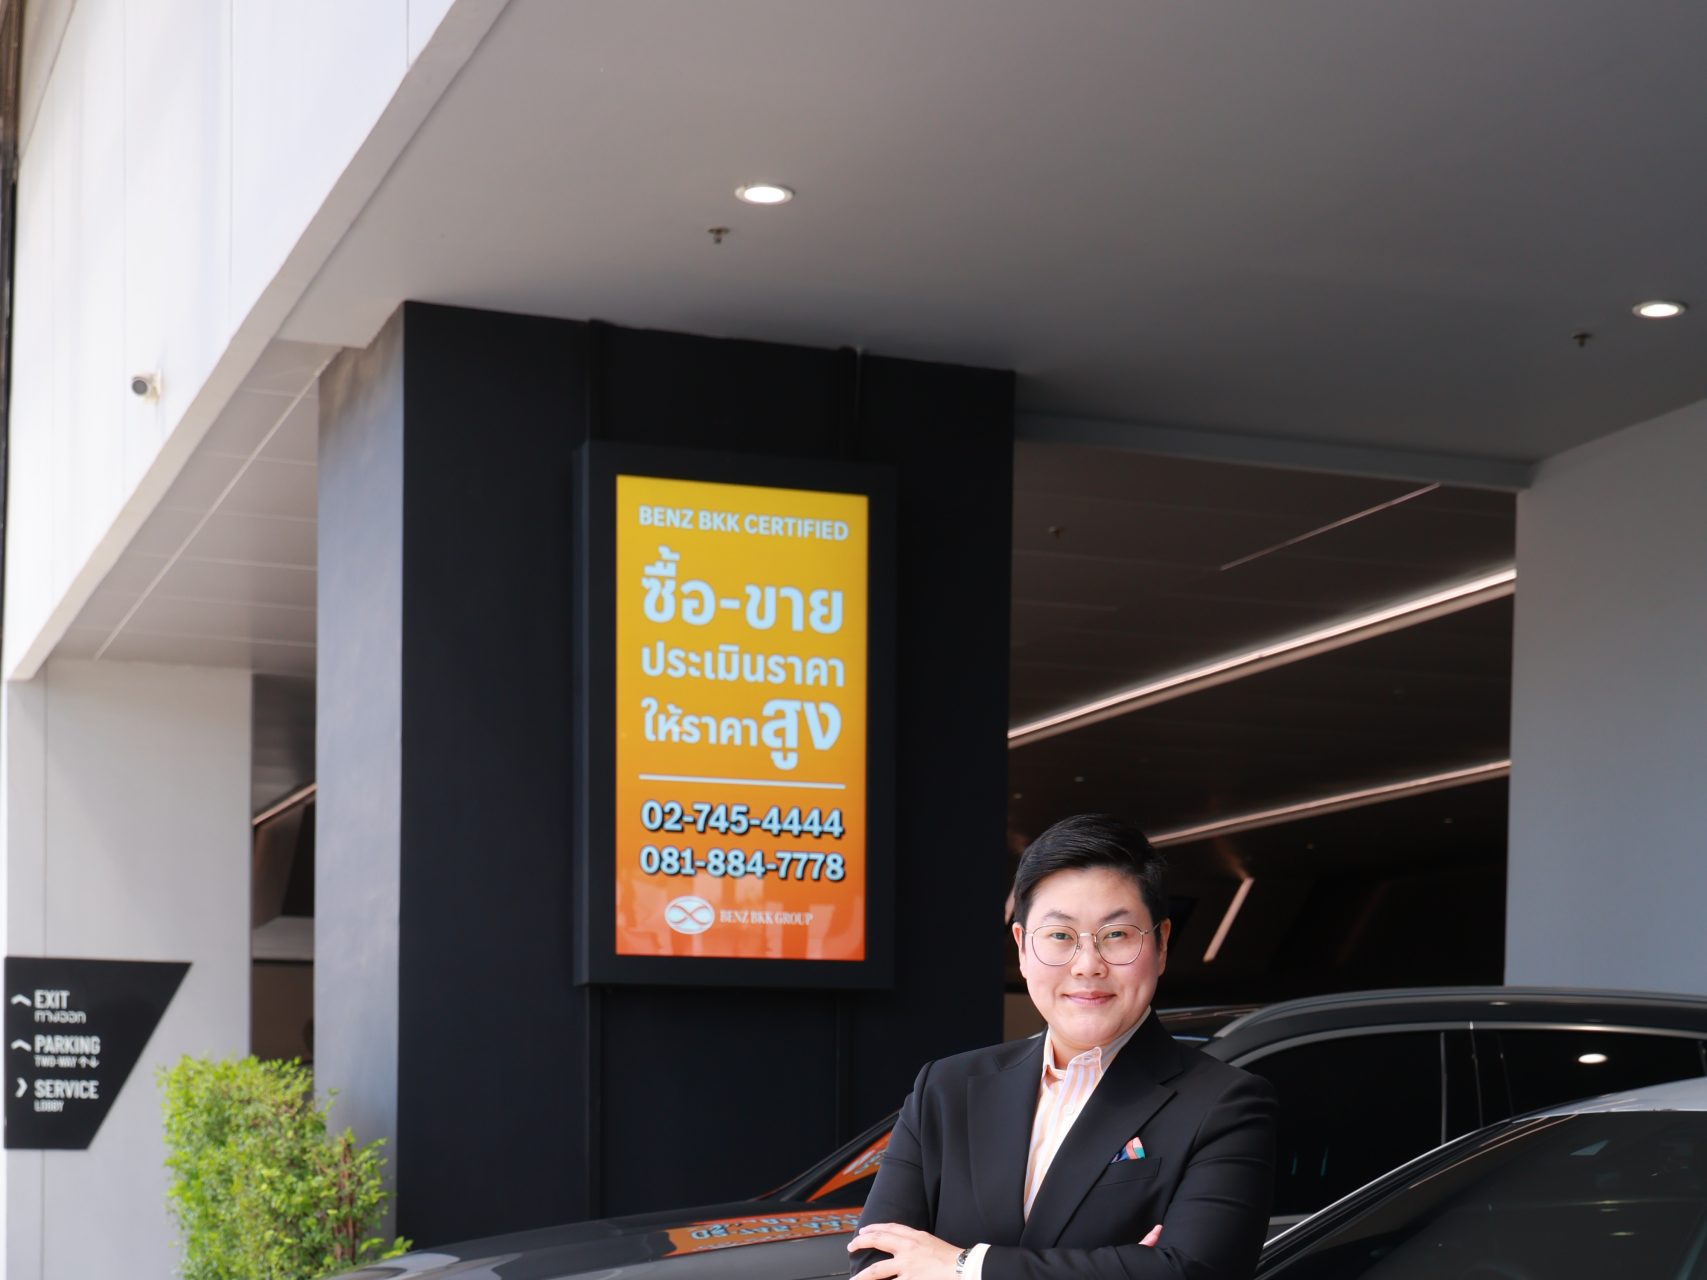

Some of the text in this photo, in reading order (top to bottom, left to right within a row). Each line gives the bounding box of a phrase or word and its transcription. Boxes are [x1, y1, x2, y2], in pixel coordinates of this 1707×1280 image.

[639, 504, 849, 541] BENZ BKK CERTIFIED
[641, 545, 843, 634] ซื้อ-ขาย
[641, 641, 845, 687] ประเมินราคา
[640, 800, 845, 838] 02-745-4444
[639, 845, 846, 882] 081-884-7778
[720, 909, 813, 927] BENZ BKK GROUP
[34, 989, 70, 1010] EXIT
[34, 1010, 87, 1024] ทางออก
[34, 1034, 100, 1055] PARKING
[34, 1055, 77, 1068] TWO-WAY
[34, 1079, 99, 1099] SERVICE
[34, 1100, 64, 1112] LOBBY
